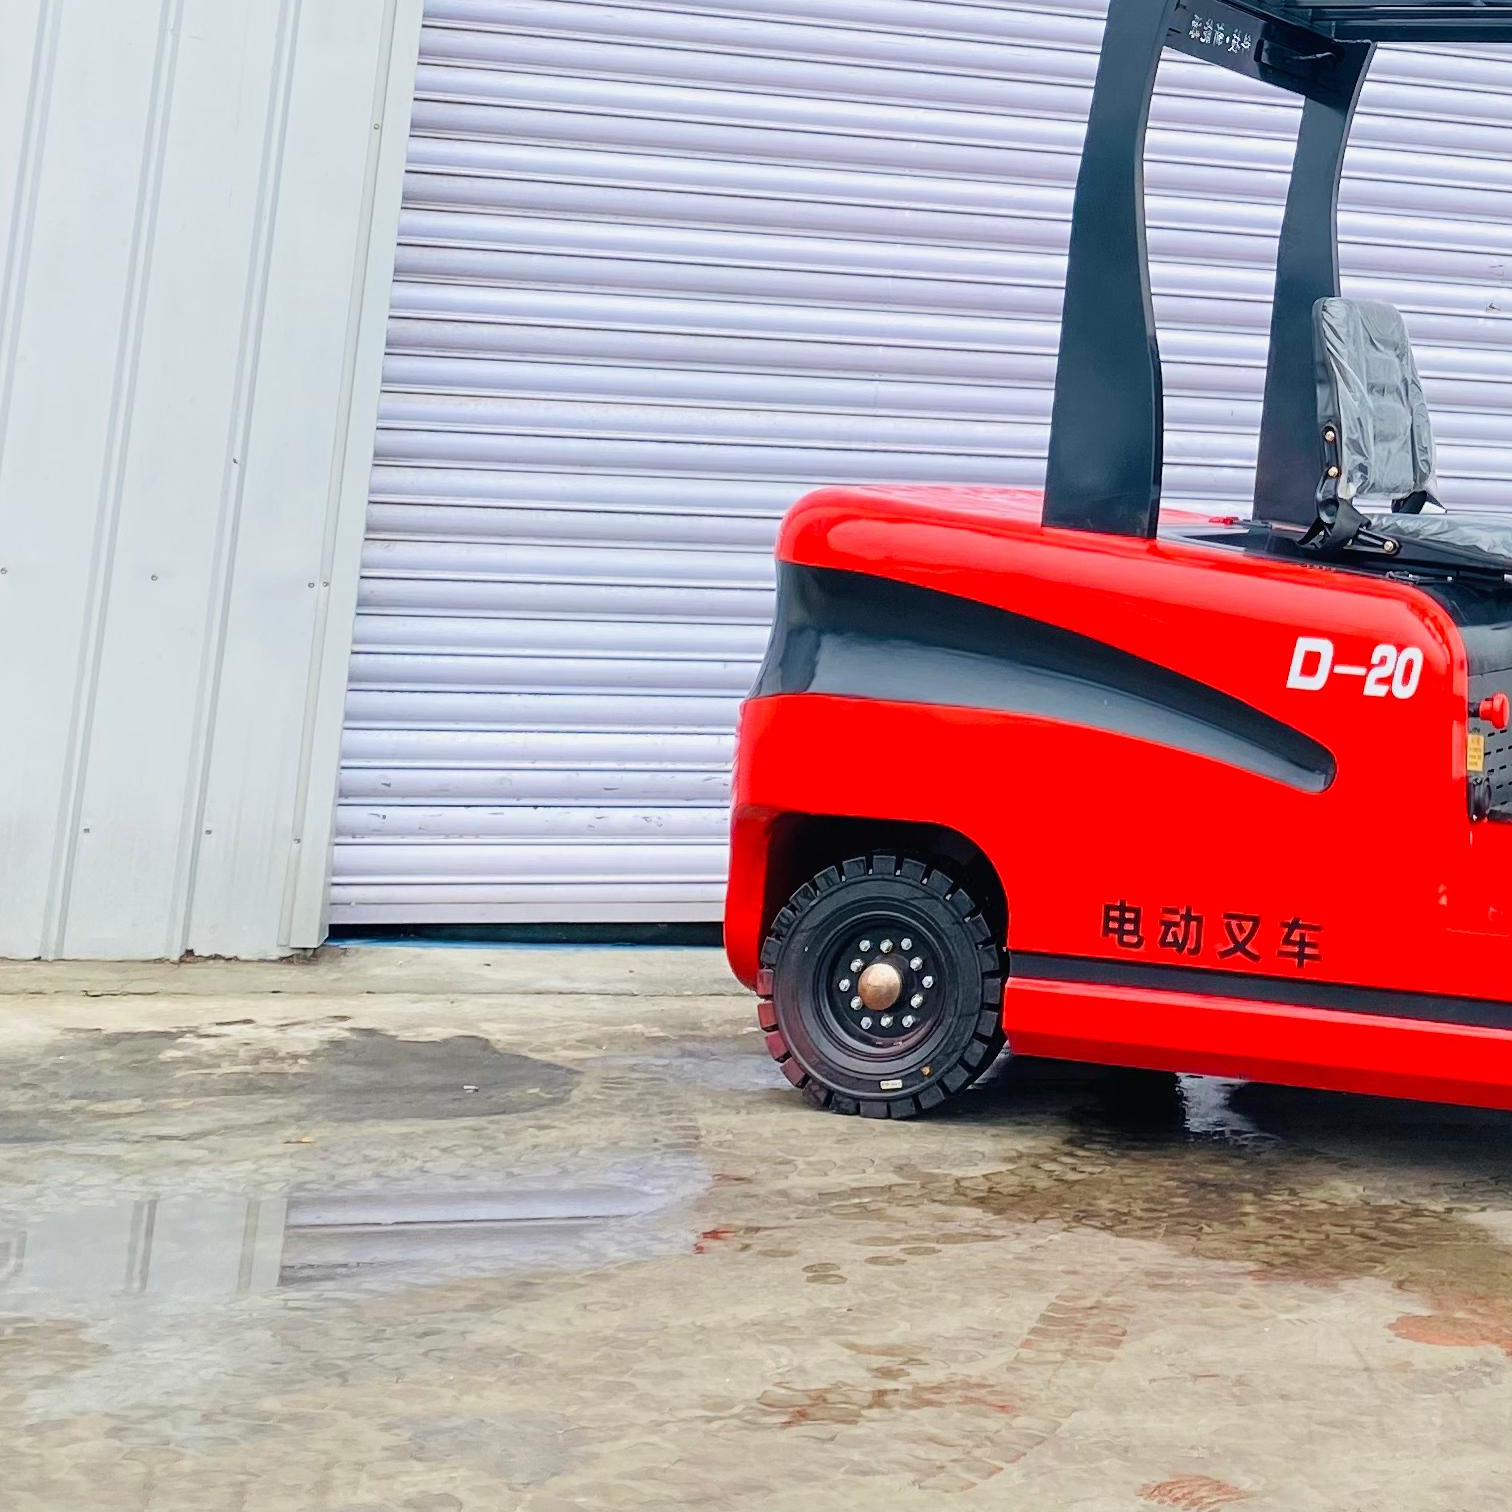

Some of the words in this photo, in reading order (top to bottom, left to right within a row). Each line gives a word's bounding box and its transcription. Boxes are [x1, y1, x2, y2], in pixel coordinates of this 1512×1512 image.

[1286, 636, 1424, 699] D-20
[1102, 899, 1323, 968] 电动叉车
